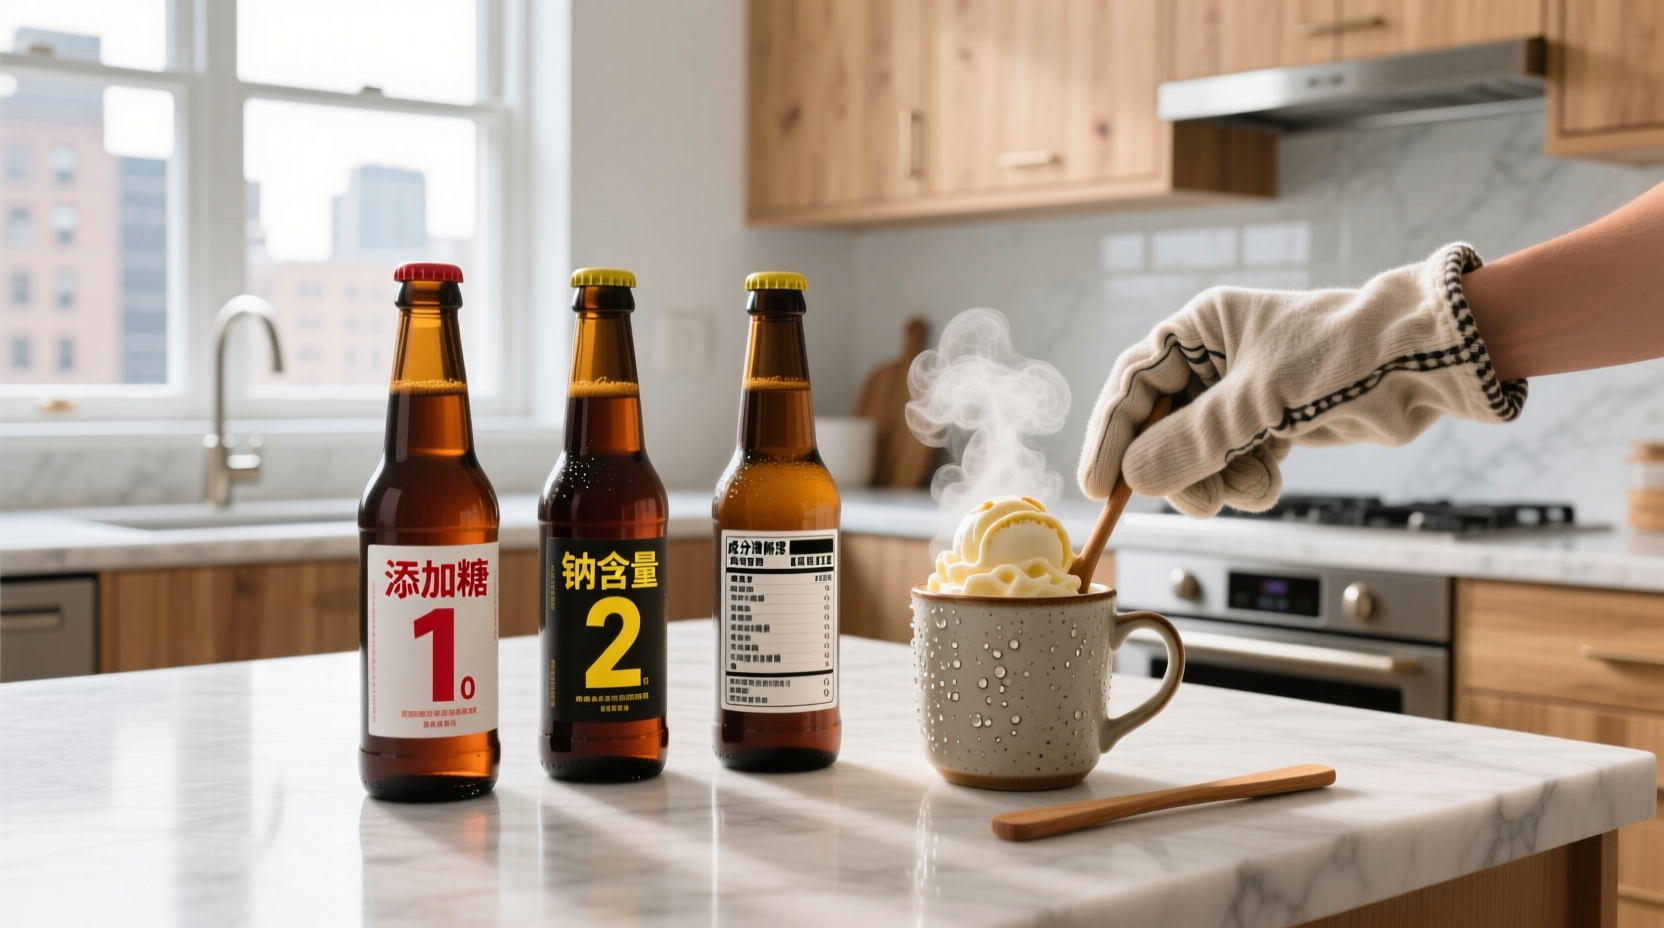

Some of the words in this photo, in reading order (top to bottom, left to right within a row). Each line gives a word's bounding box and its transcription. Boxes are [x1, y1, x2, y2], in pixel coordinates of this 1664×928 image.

[385, 558, 489, 599] 添加糖
[562, 550, 659, 590] 钠含量
[413, 607, 455, 702] 1
[585, 596, 641, 689] 2
